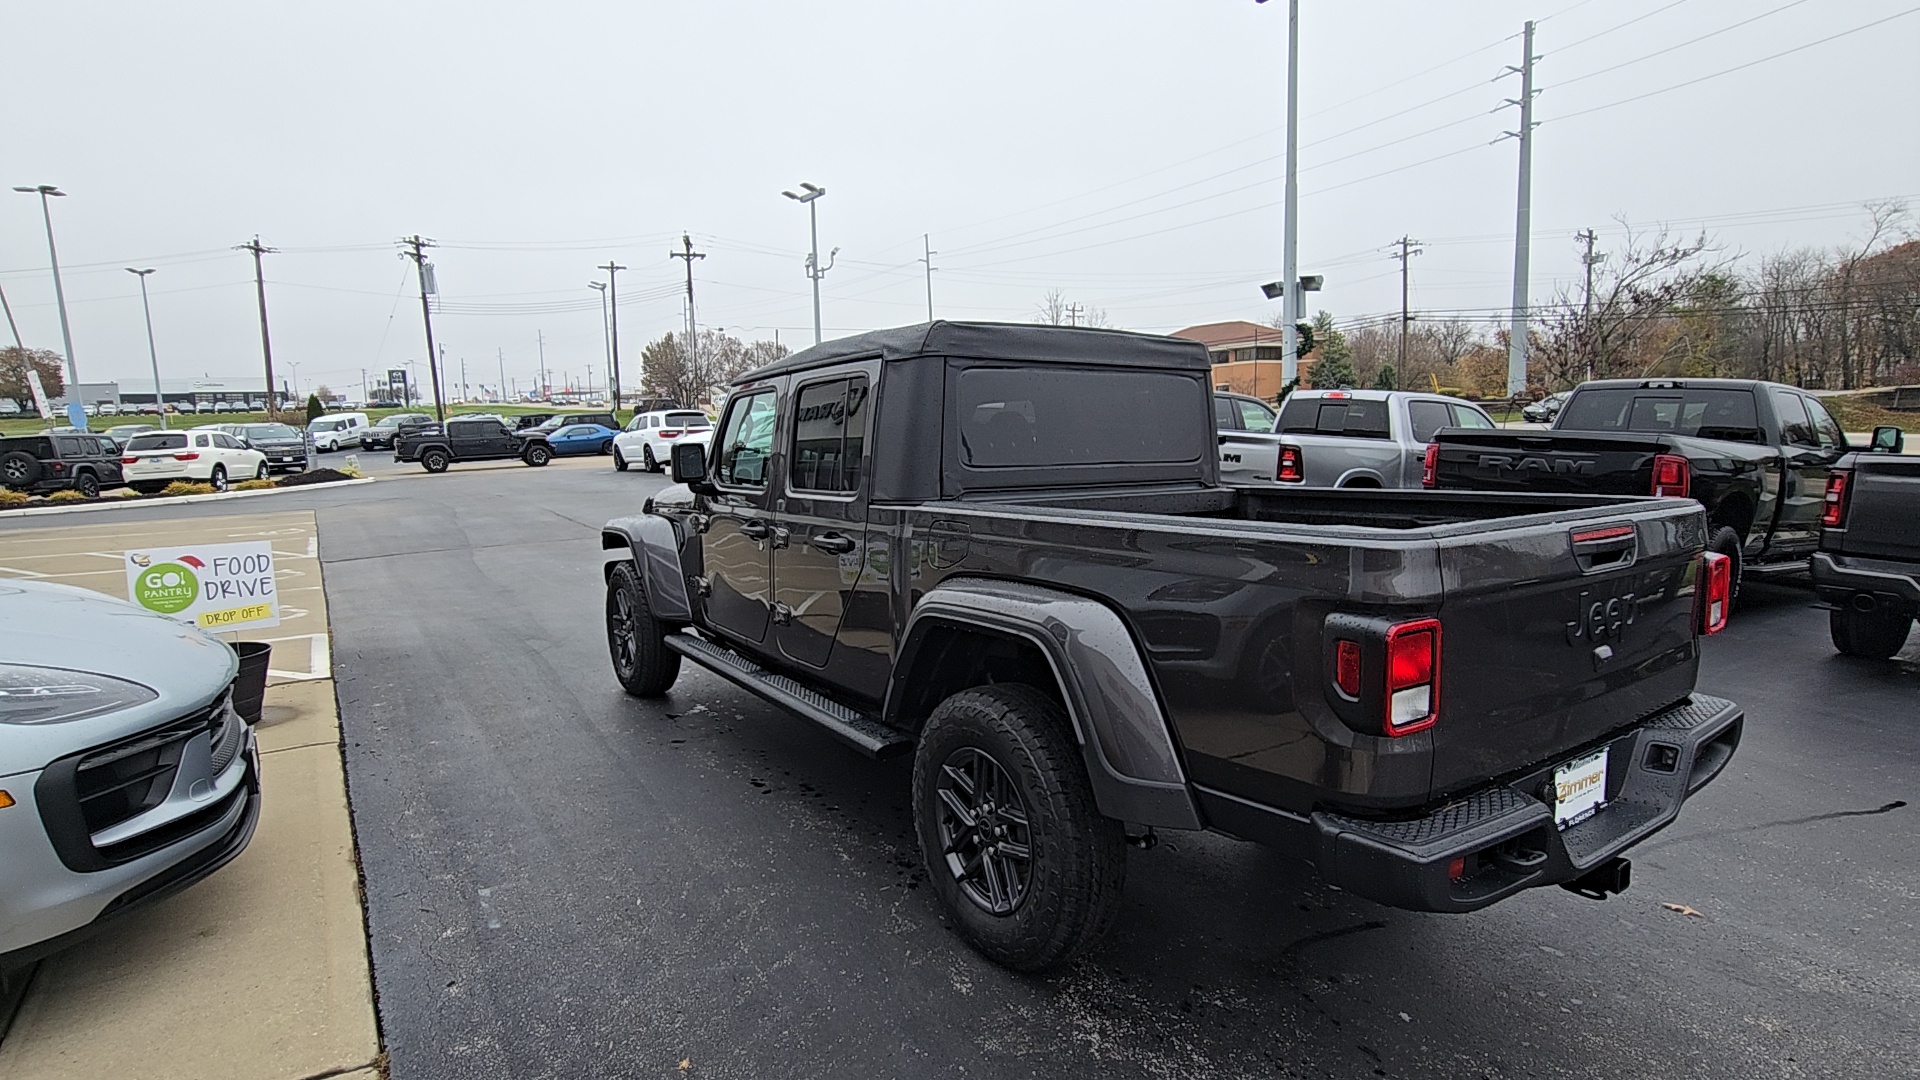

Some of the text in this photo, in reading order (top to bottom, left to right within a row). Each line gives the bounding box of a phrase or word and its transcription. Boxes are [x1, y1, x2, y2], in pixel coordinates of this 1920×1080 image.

[1479, 454, 1596, 476] RAM
[213, 553, 271, 577] FOOD
[145, 571, 186, 589] GO!
[204, 576, 273, 601] DRIVE
[144, 586, 192, 599] PANTRY
[205, 605, 265, 625] DROP OFF
[1566, 591, 1635, 647] Jeep
